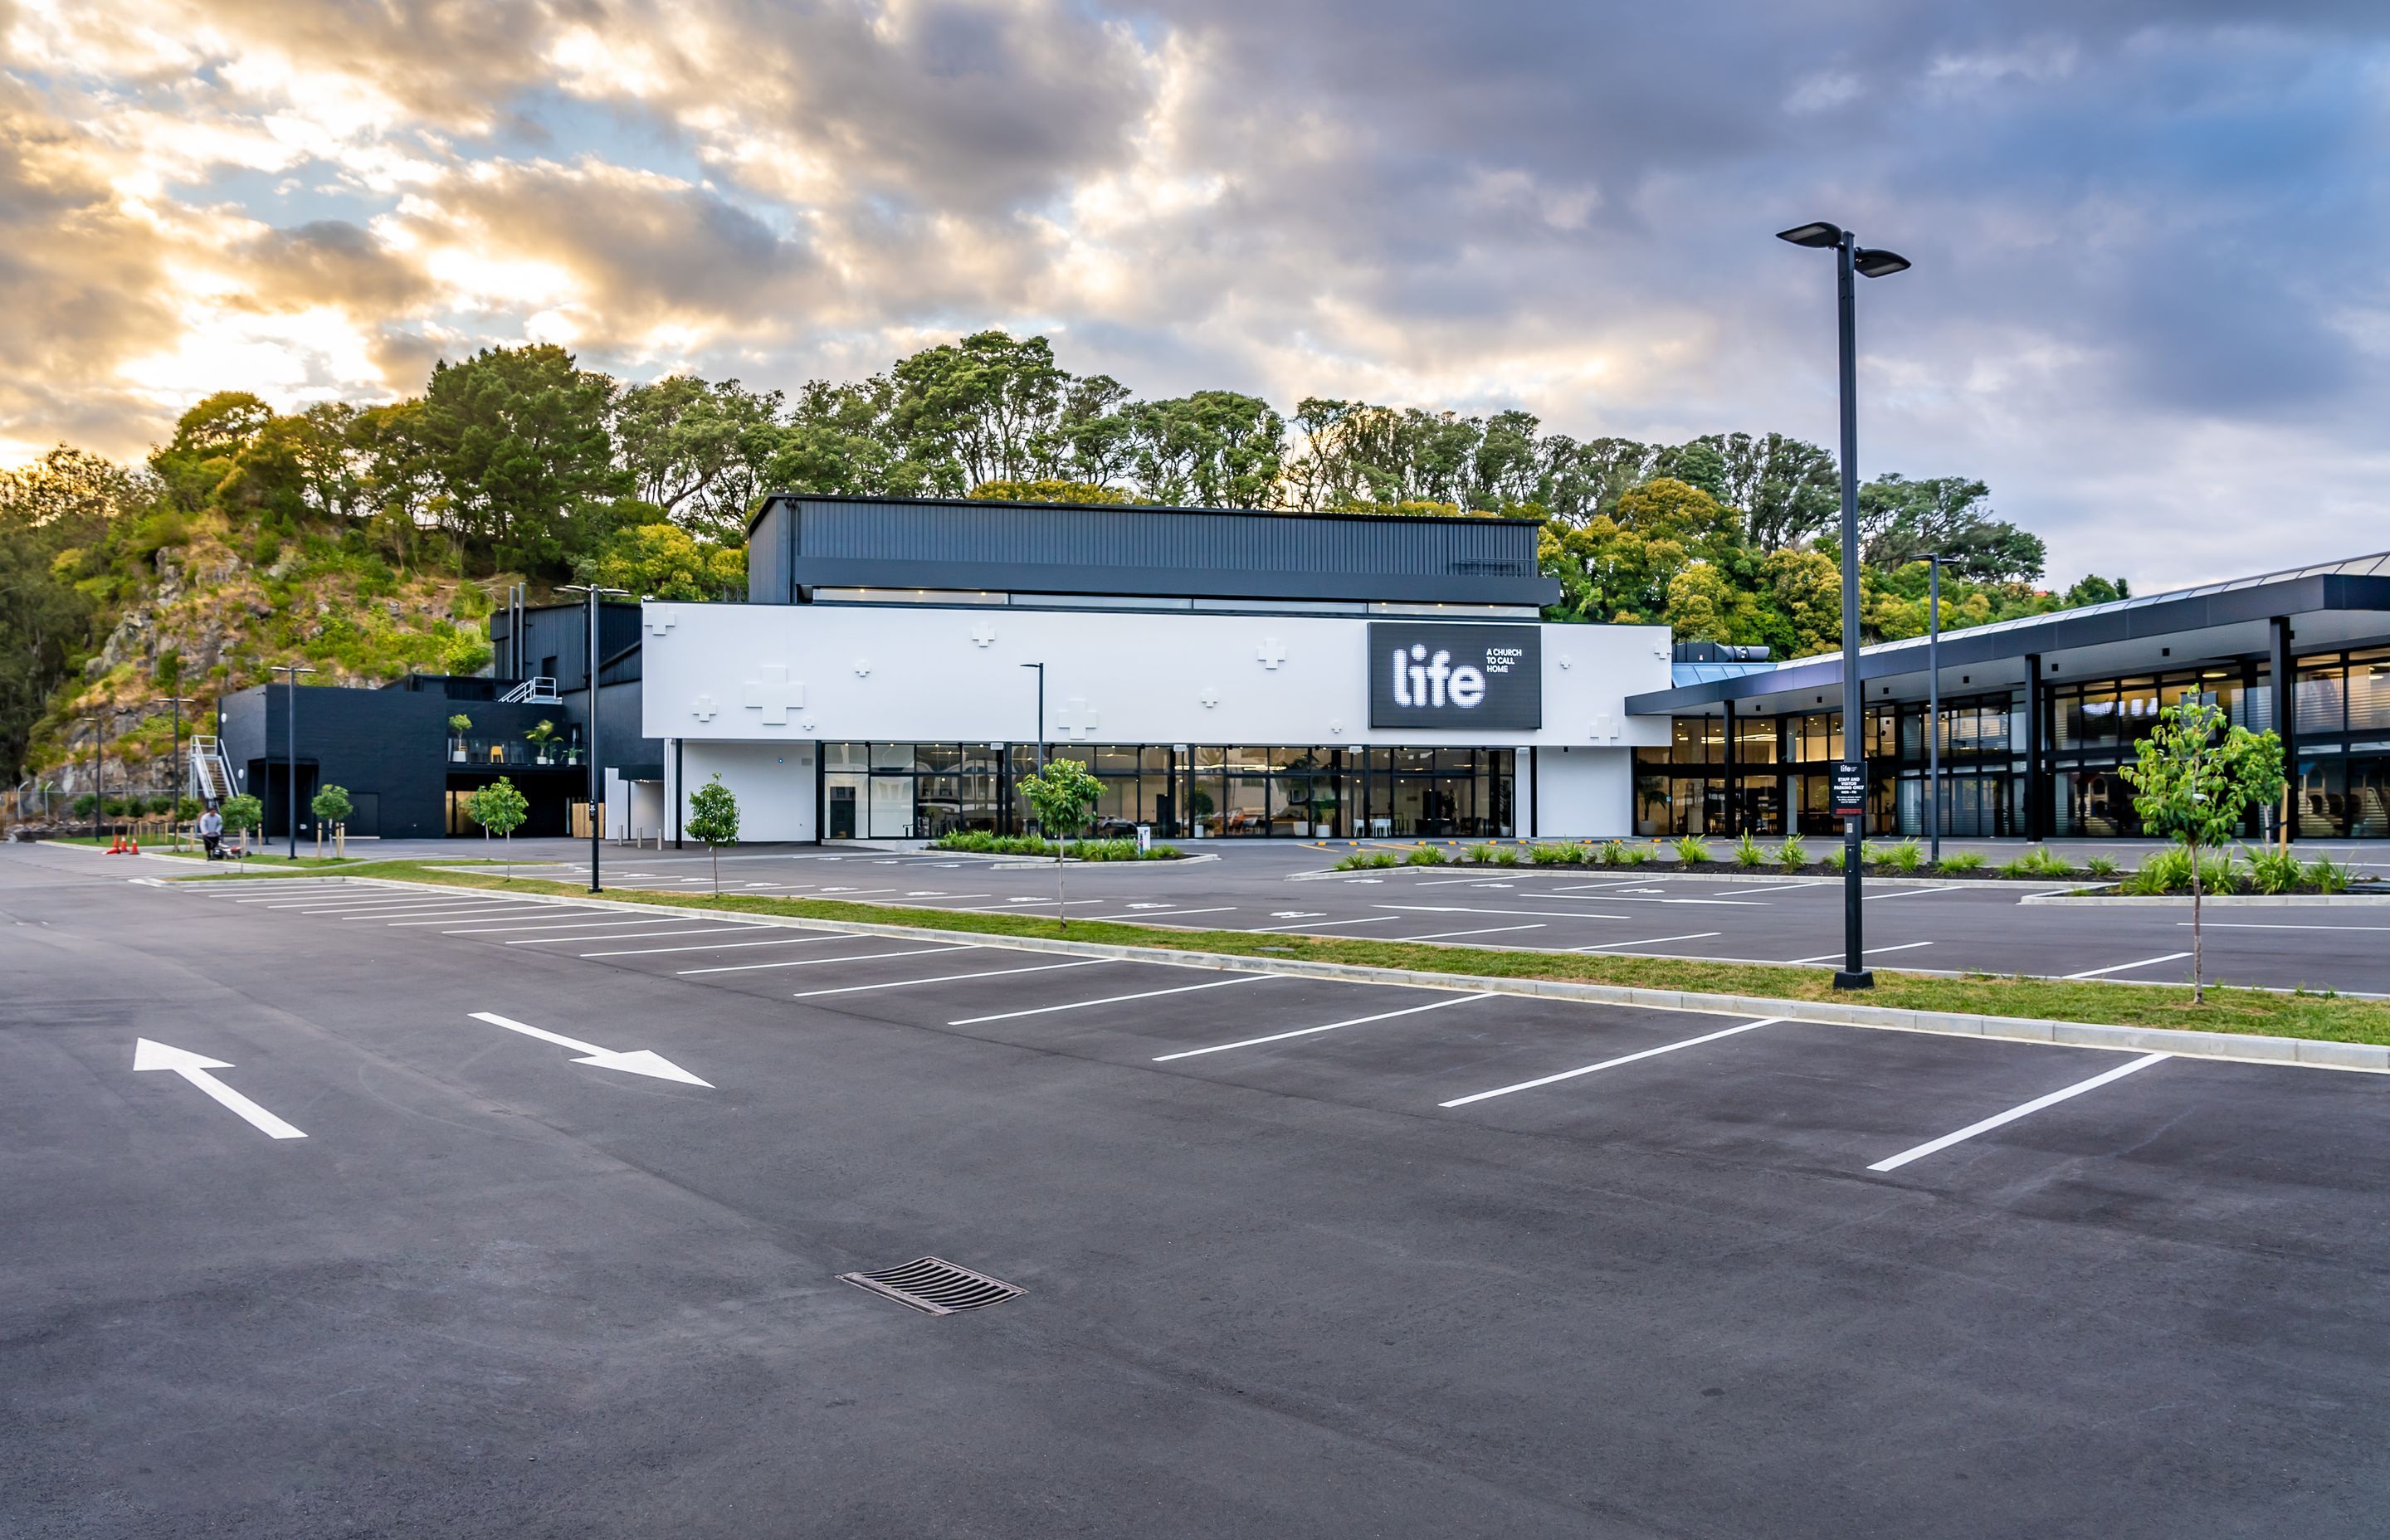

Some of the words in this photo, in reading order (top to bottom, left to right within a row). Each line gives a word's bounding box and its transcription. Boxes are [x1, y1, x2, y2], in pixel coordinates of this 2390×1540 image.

[1493, 648, 1522, 656] CHURCH
[1497, 656, 1514, 665] CALL
[1486, 665, 1508, 673] HOME
[1393, 644, 1485, 708] life
